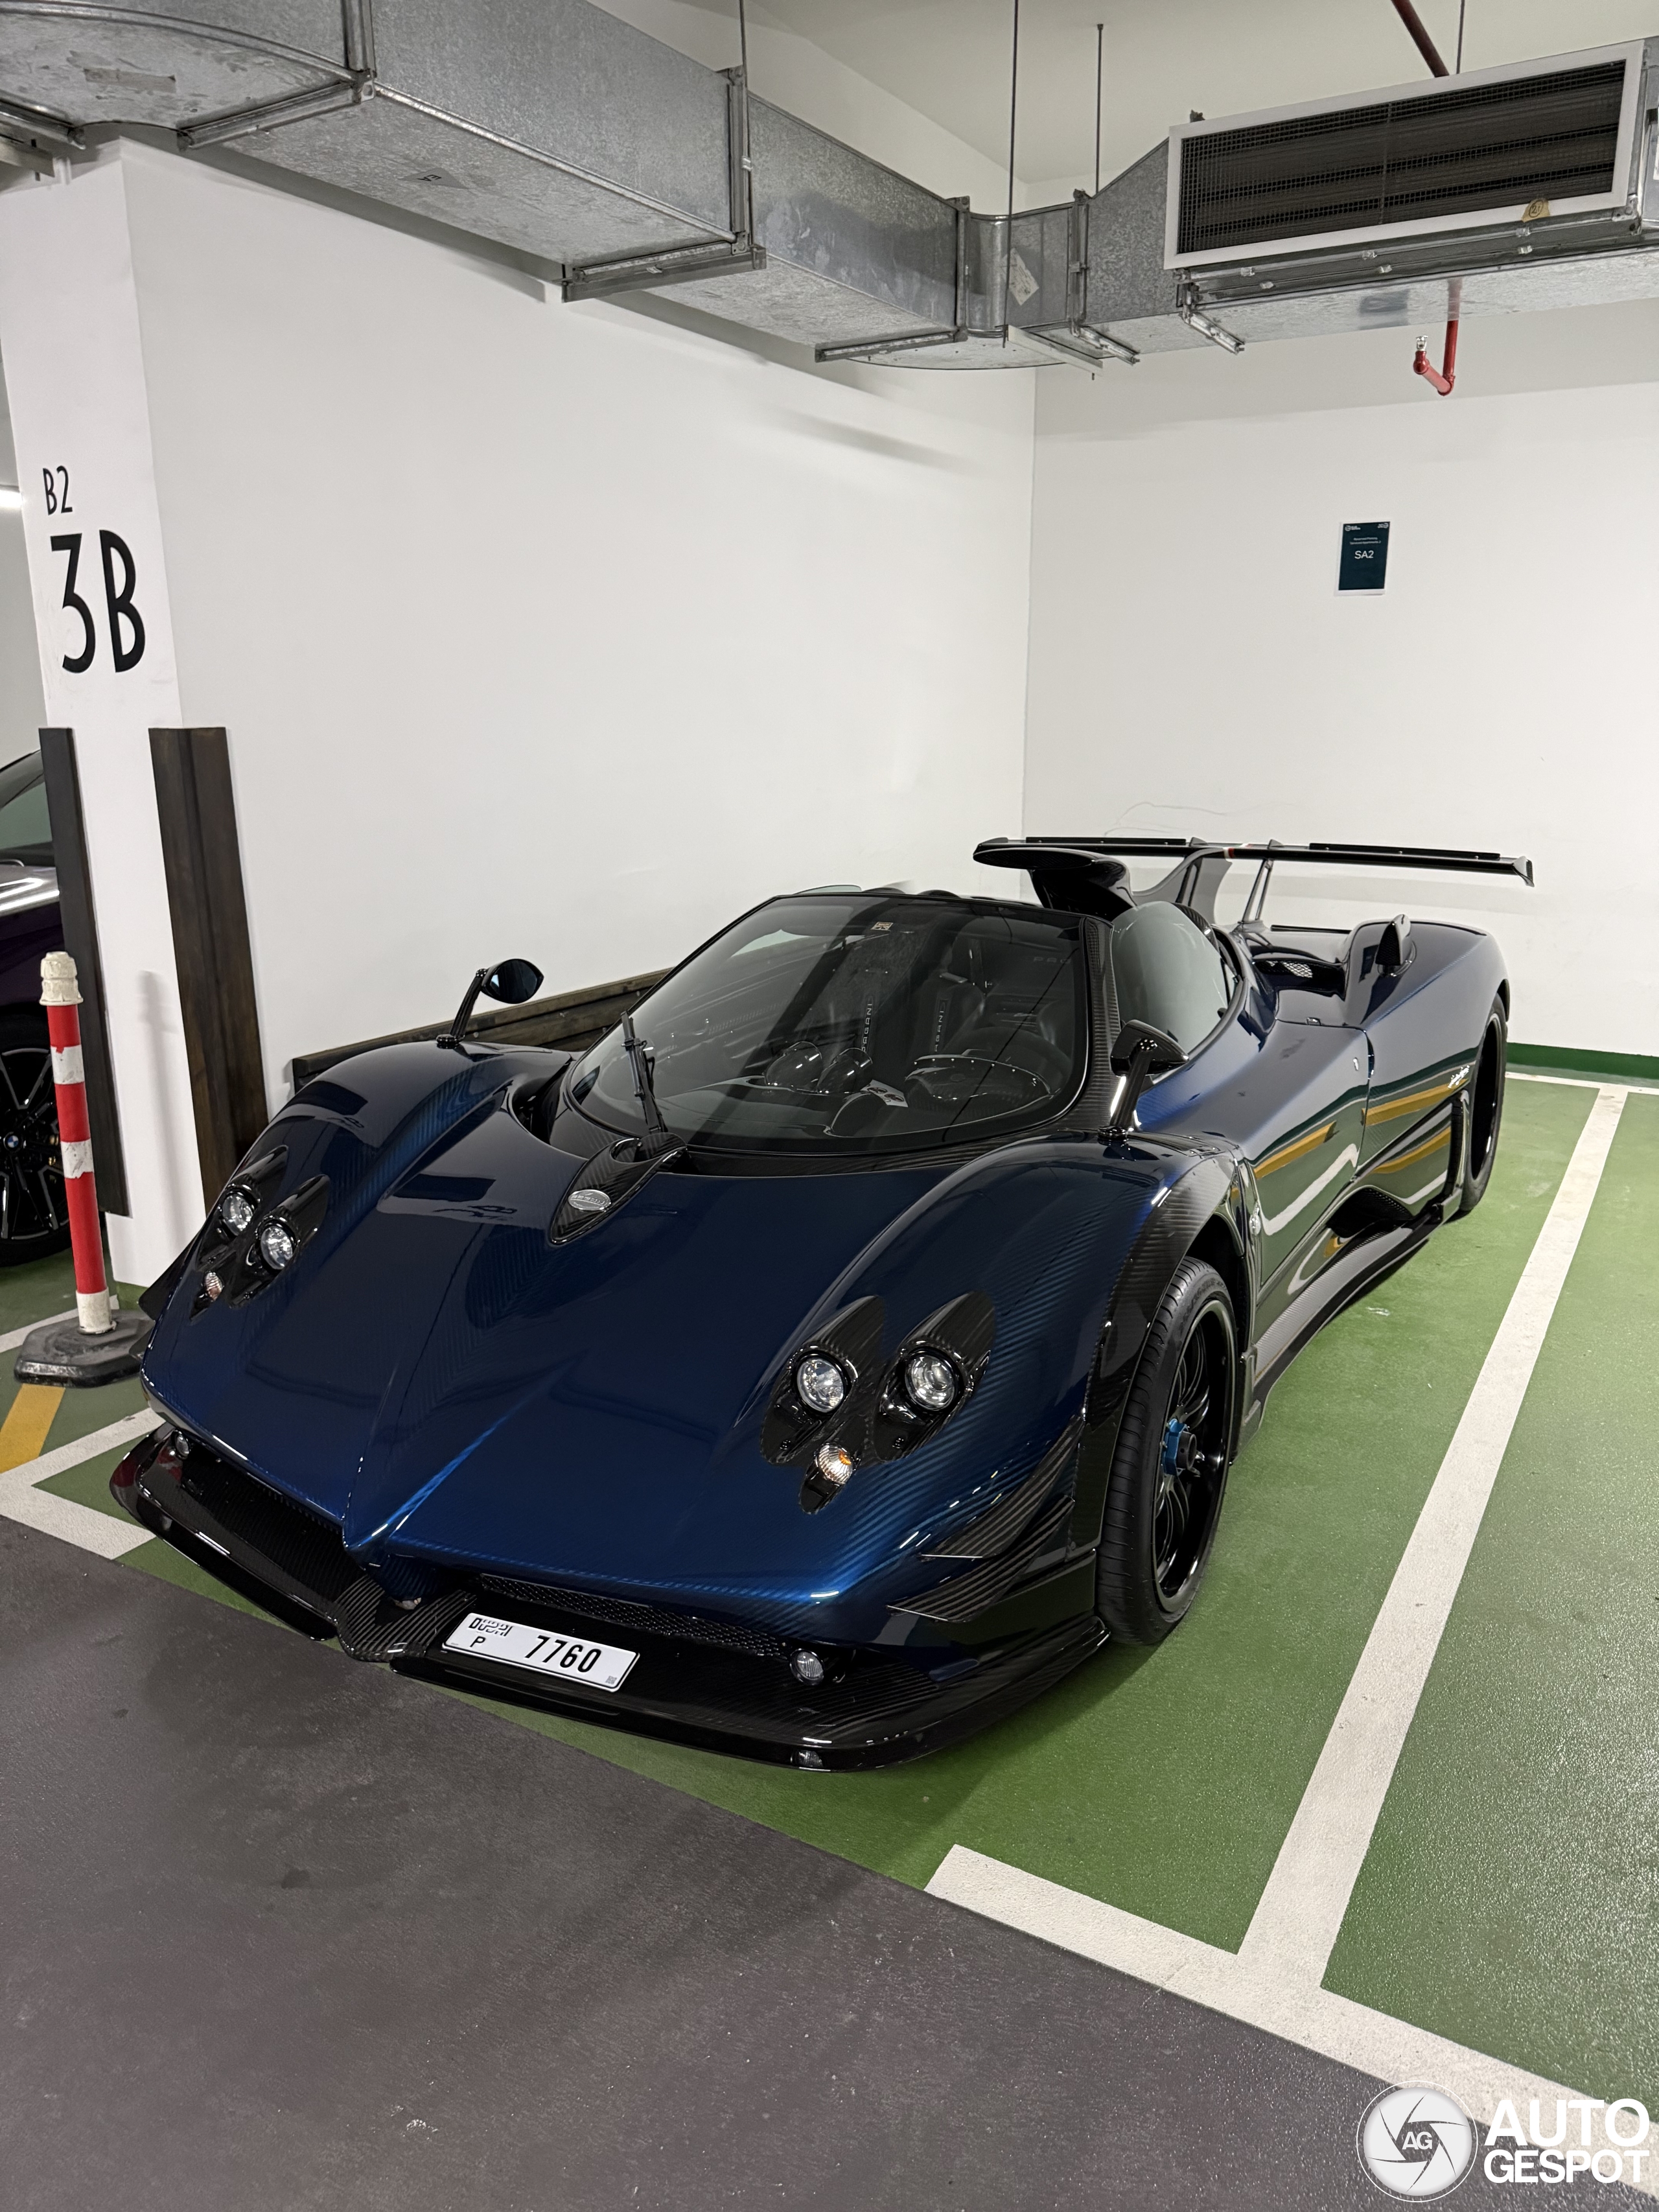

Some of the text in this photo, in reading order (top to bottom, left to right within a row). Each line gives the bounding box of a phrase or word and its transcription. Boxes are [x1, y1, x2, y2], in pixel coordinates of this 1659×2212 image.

[43, 465, 73, 515] B2
[1354, 550, 1374, 559] SA2
[50, 530, 145, 673] 3B
[934, 1010, 944, 1053] AGANI
[470, 1636, 486, 1647] P
[524, 1635, 601, 1672] 7760
